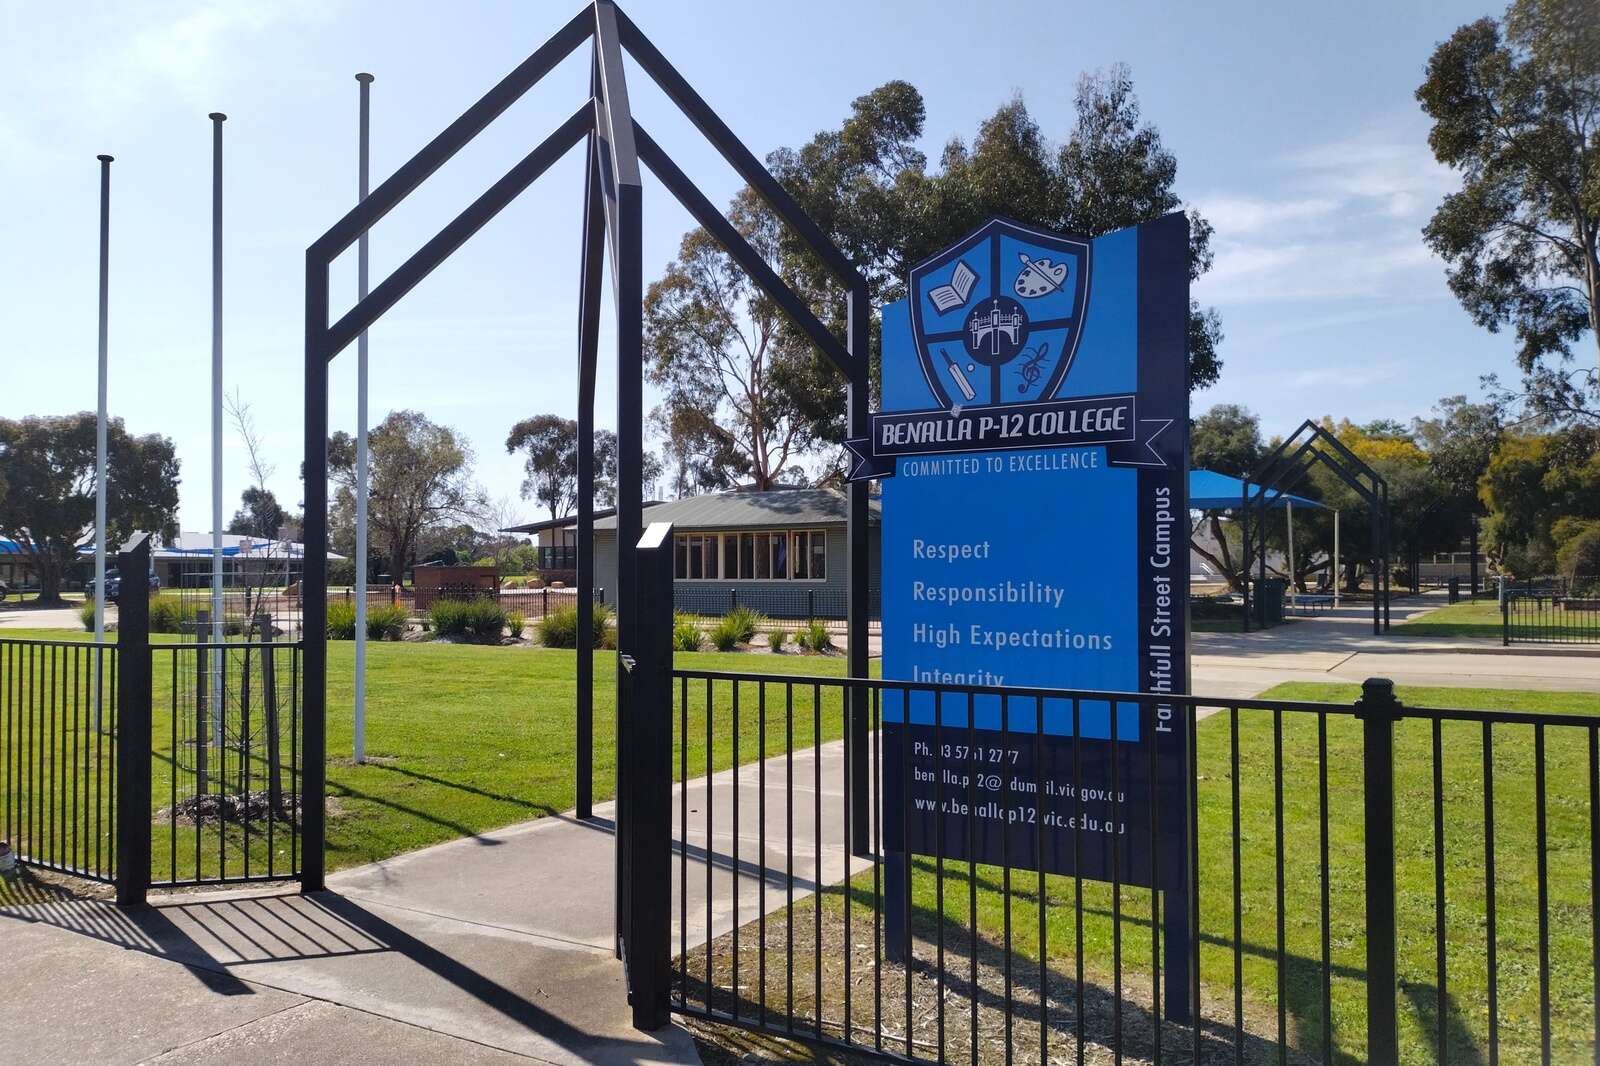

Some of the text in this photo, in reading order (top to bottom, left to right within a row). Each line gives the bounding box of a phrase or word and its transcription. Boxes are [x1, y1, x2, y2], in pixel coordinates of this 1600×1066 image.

[881, 406, 1127, 446] BENALLA P-12 COLLEGE
[903, 451, 1098, 477] COMMITTED TO EXCELLENCE
[913, 539, 990, 563] Respect
[913, 580, 1065, 608] Responsibility
[1149, 486, 1175, 732] Fahfull Street Campus
[913, 623, 1113, 650] High Expectations
[914, 742, 933, 756] Ph.
[955, 745, 983, 761] 571
